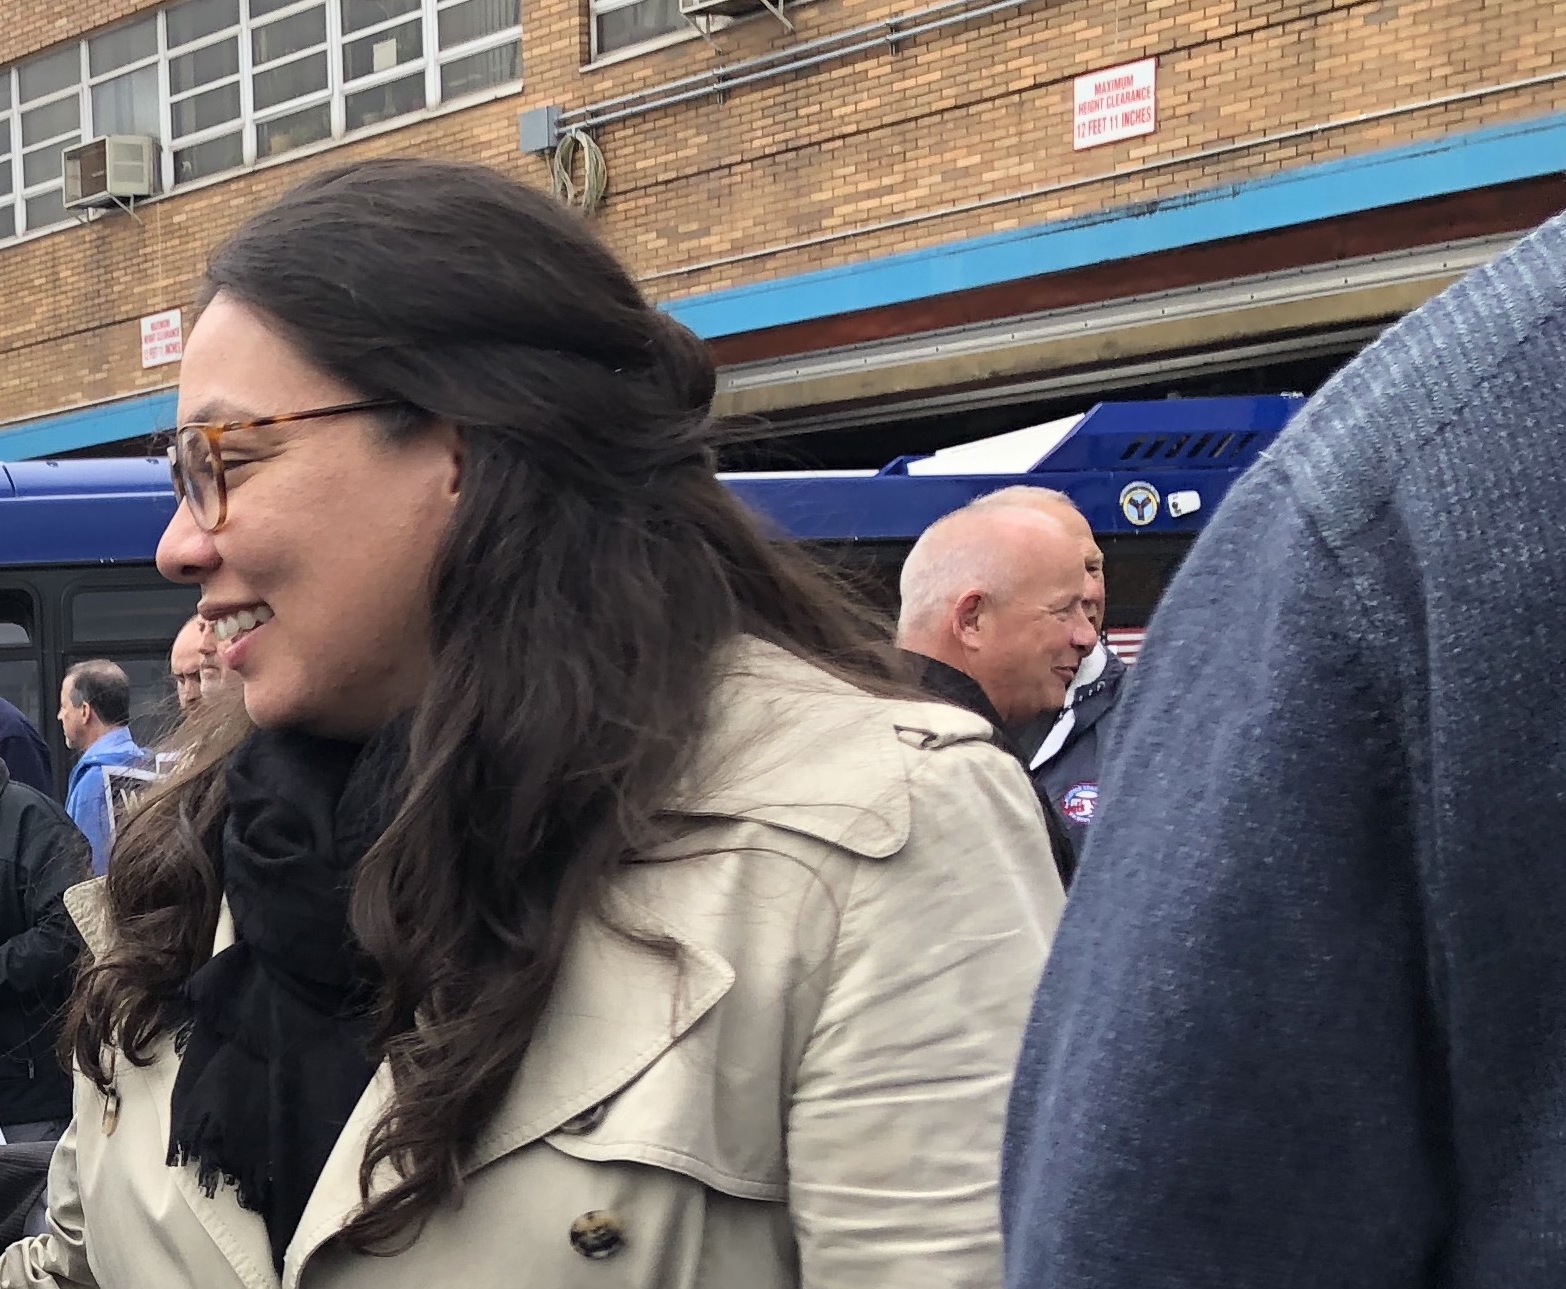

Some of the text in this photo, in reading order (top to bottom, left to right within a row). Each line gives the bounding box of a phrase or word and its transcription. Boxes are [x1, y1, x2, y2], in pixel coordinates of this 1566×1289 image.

[1079, 85, 1151, 115] HEIGHT CLEARANCE
[1095, 75, 1134, 96] MAXIMUM
[1077, 106, 1152, 139] 12 FEET 11 INCHES
